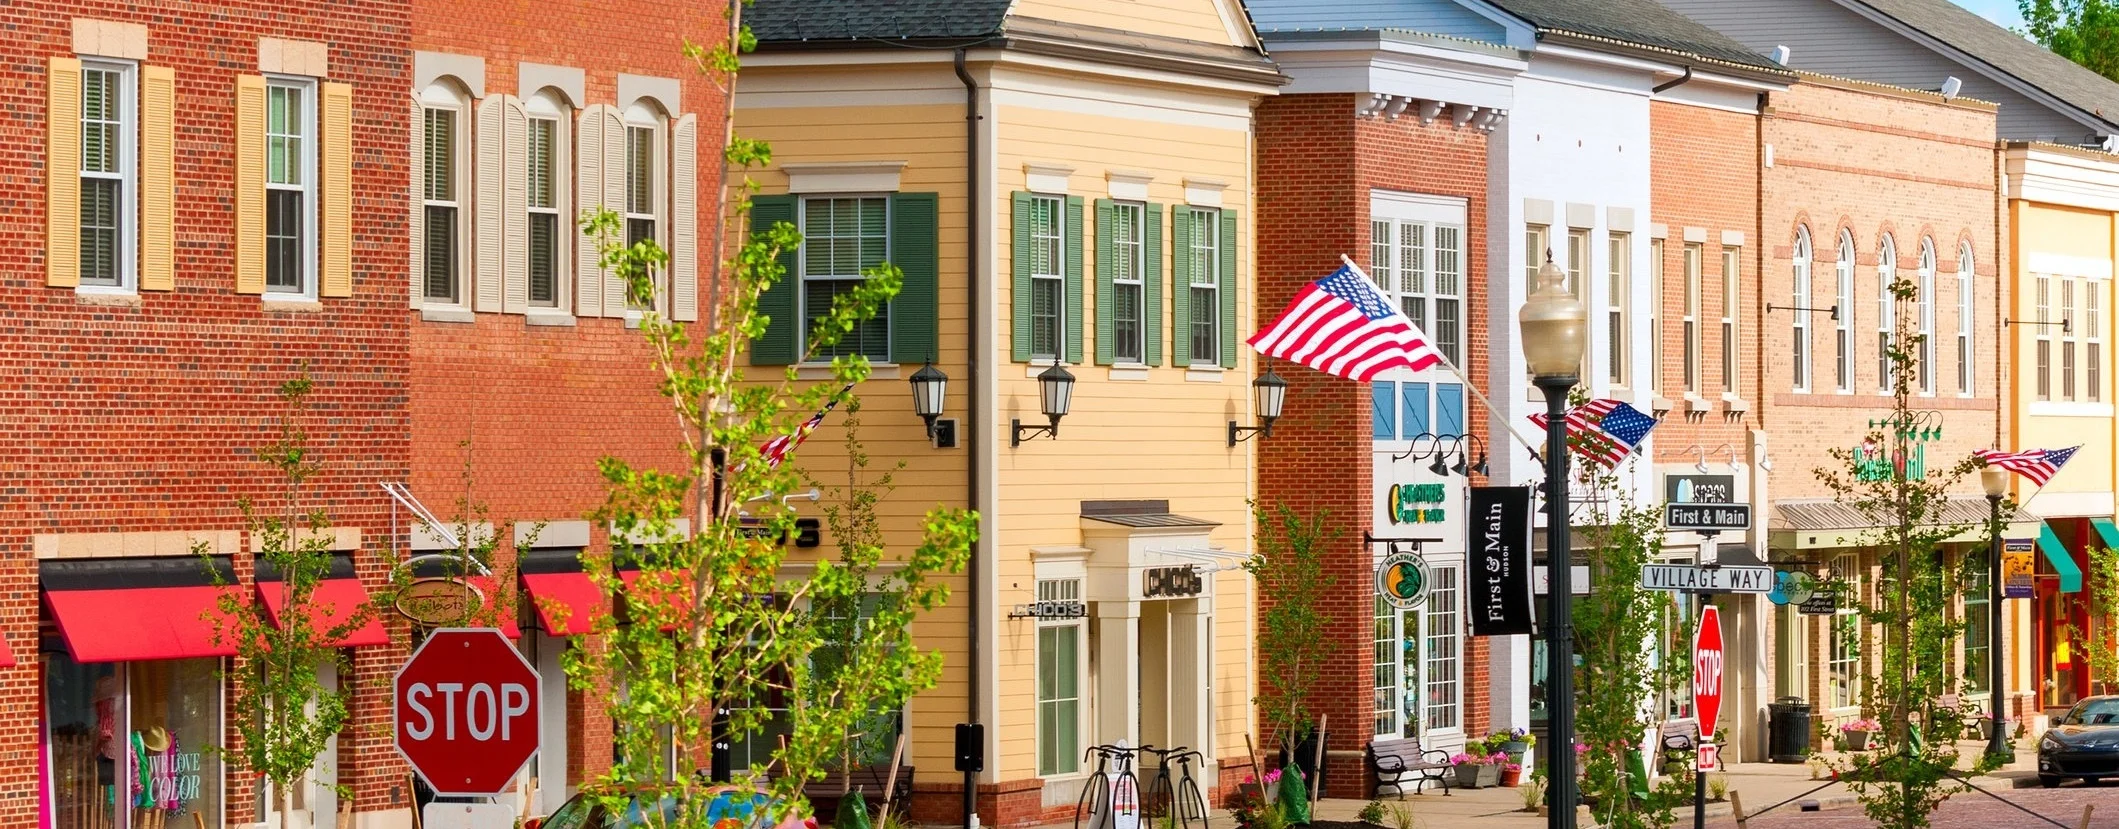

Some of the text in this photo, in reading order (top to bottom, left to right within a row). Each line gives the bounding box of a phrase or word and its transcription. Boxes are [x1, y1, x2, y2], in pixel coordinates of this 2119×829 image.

[1672, 509, 1745, 525] First & Main
[1386, 555, 1423, 568] HEATHER'S
[1485, 503, 1504, 621] First & Main
[1651, 568, 1763, 589] VILLAGE WAY
[1773, 582, 1811, 594] pec
[1384, 592, 1397, 603] HEAT
[1696, 648, 1721, 696] STOP
[406, 682, 530, 741] STOP
[148, 752, 200, 773] WE LOVE
[149, 774, 200, 802] COLOR
